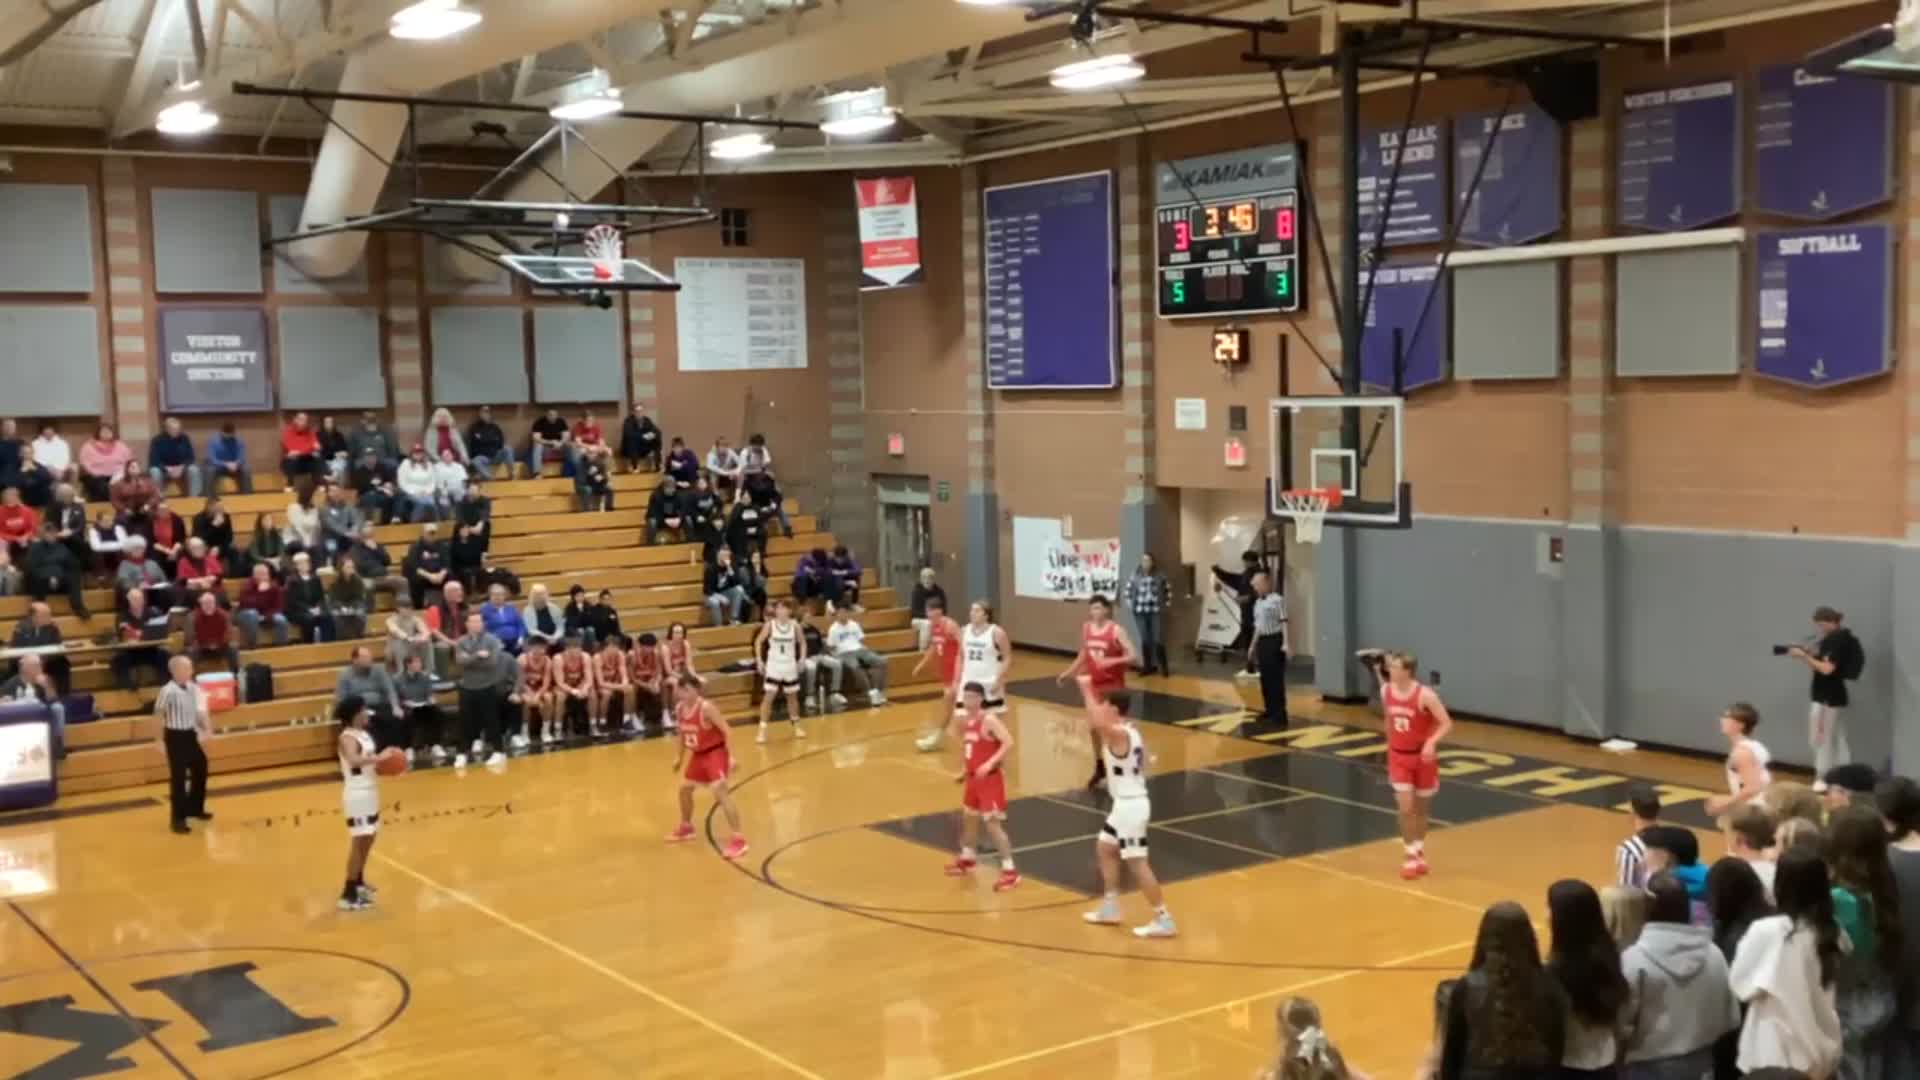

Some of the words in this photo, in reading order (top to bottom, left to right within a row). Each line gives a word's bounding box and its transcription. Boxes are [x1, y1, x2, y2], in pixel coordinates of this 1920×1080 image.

[1379, 125, 1438, 148] KAIAK
[1181, 162, 1265, 188] KAMIAK
[1276, 208, 1293, 240] 8
[1174, 221, 1189, 251] 3
[1777, 233, 1862, 256] SOFTBALL
[1172, 281, 1185, 303] 5
[1276, 272, 1288, 295] 3
[186, 335, 242, 349] VISITOR
